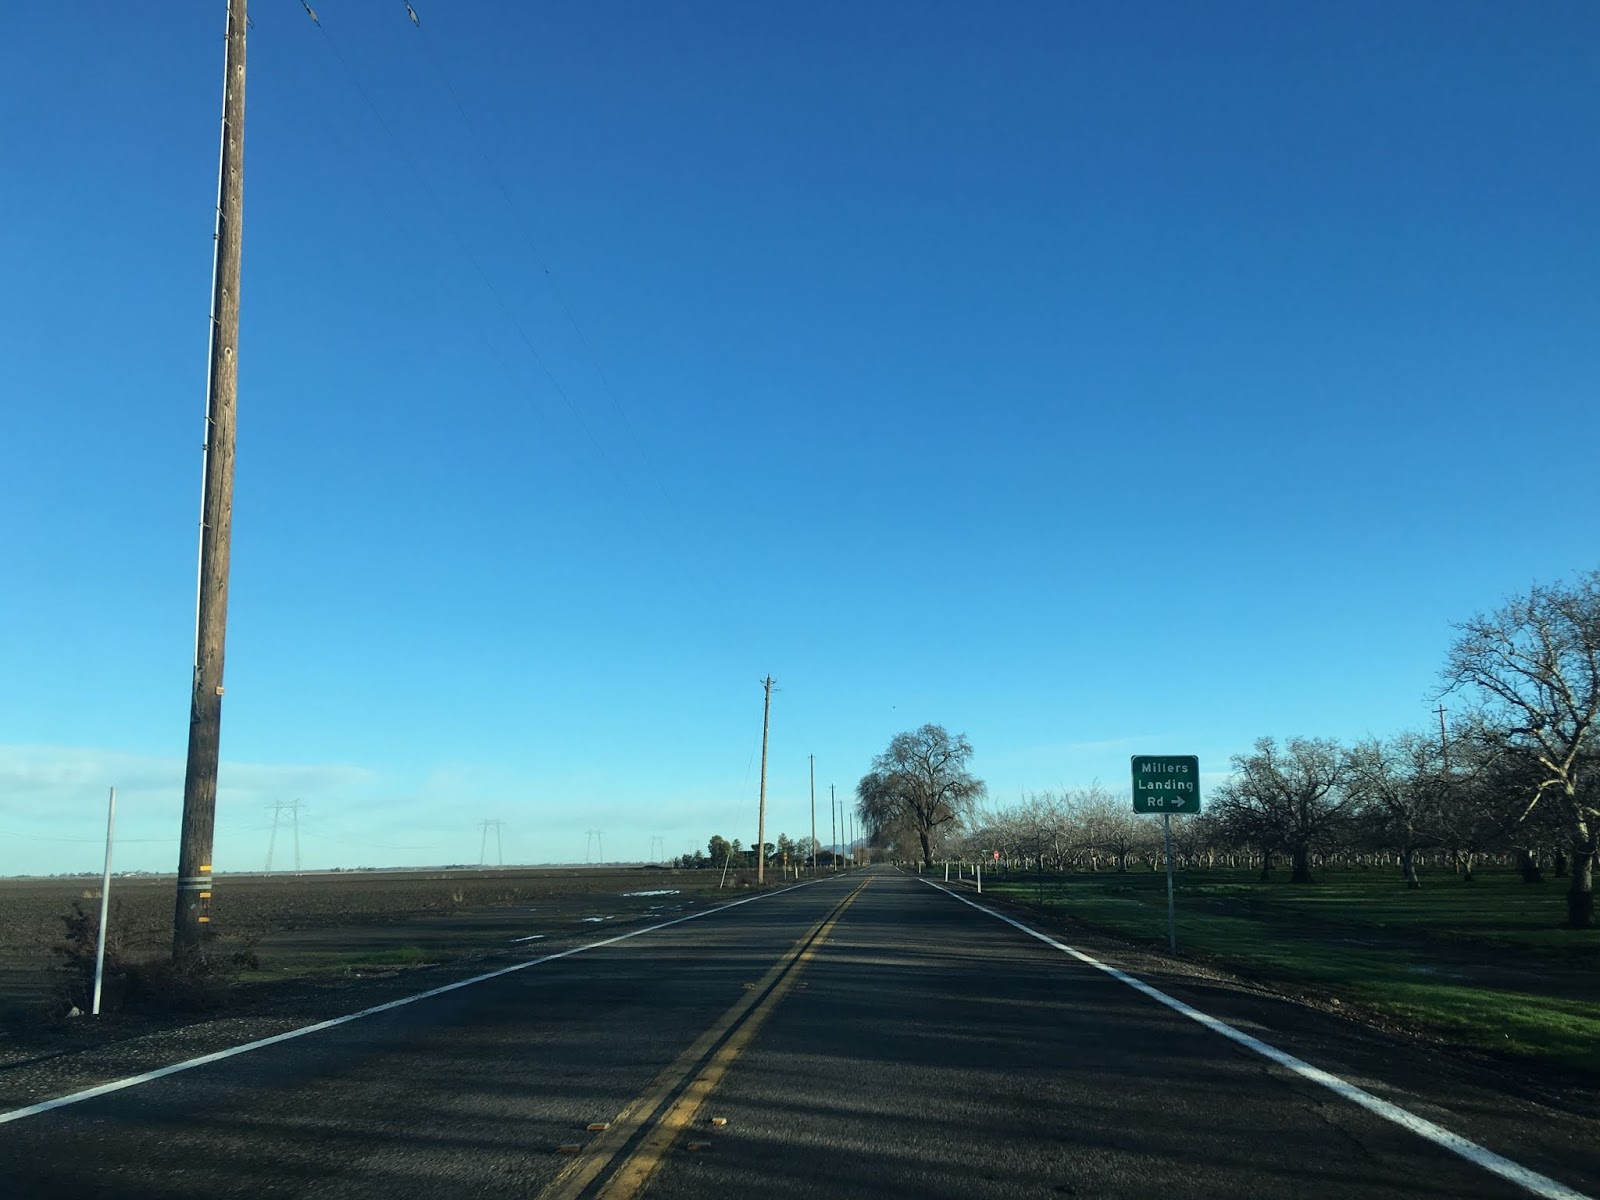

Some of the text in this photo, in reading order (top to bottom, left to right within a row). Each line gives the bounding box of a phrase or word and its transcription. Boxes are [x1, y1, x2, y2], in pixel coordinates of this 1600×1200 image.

[1141, 762, 1189, 773] Millers
[1138, 779, 1194, 793] Landing
[1147, 796, 1164, 807] Rd
